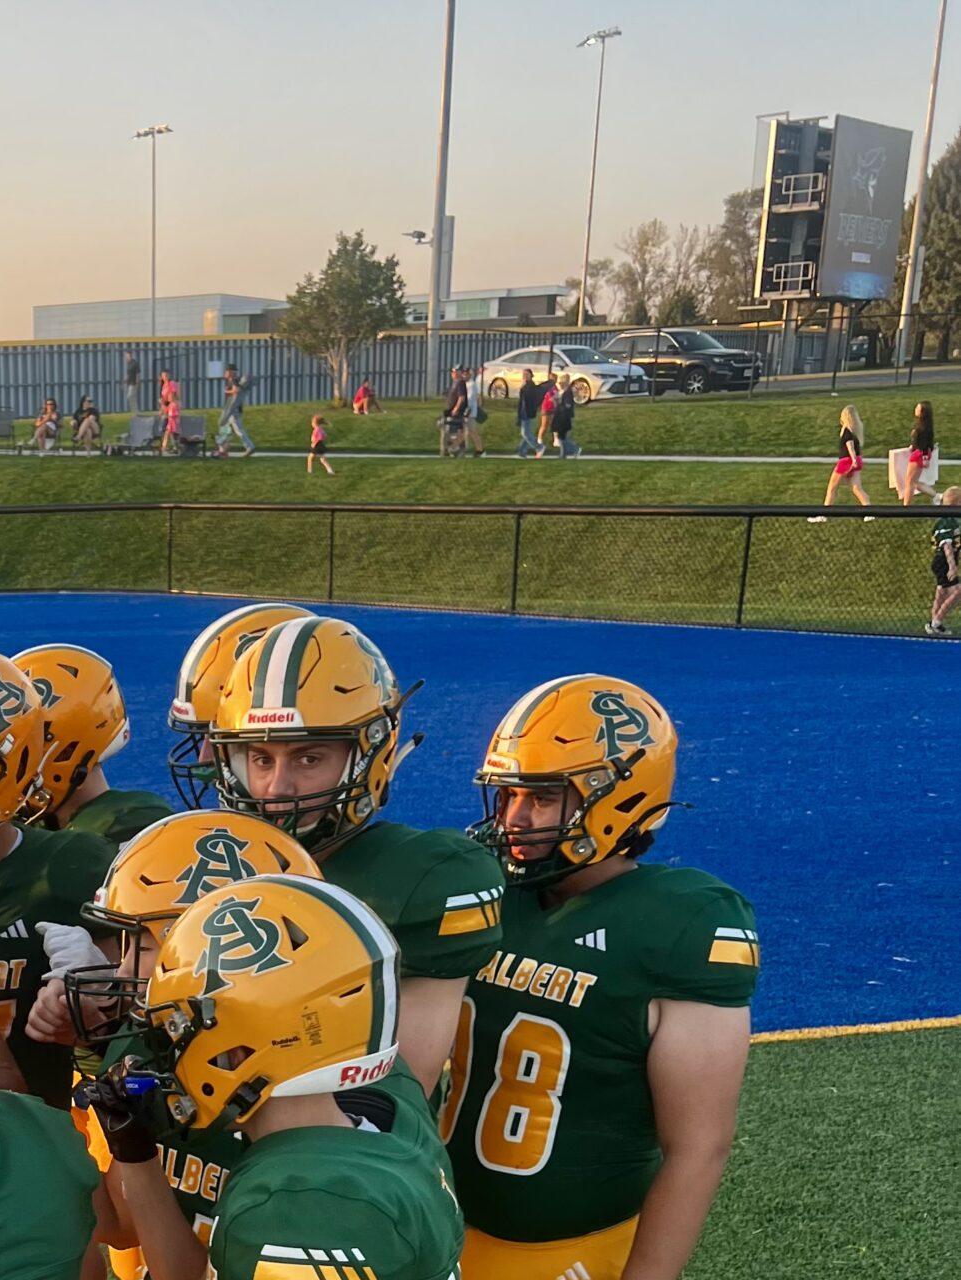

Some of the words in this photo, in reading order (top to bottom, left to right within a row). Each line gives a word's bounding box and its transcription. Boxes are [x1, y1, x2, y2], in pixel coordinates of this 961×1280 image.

[248, 712, 295, 723] Riddell
[475, 950, 598, 1008] ALBERT
[339, 1056, 395, 1087] Ridd
